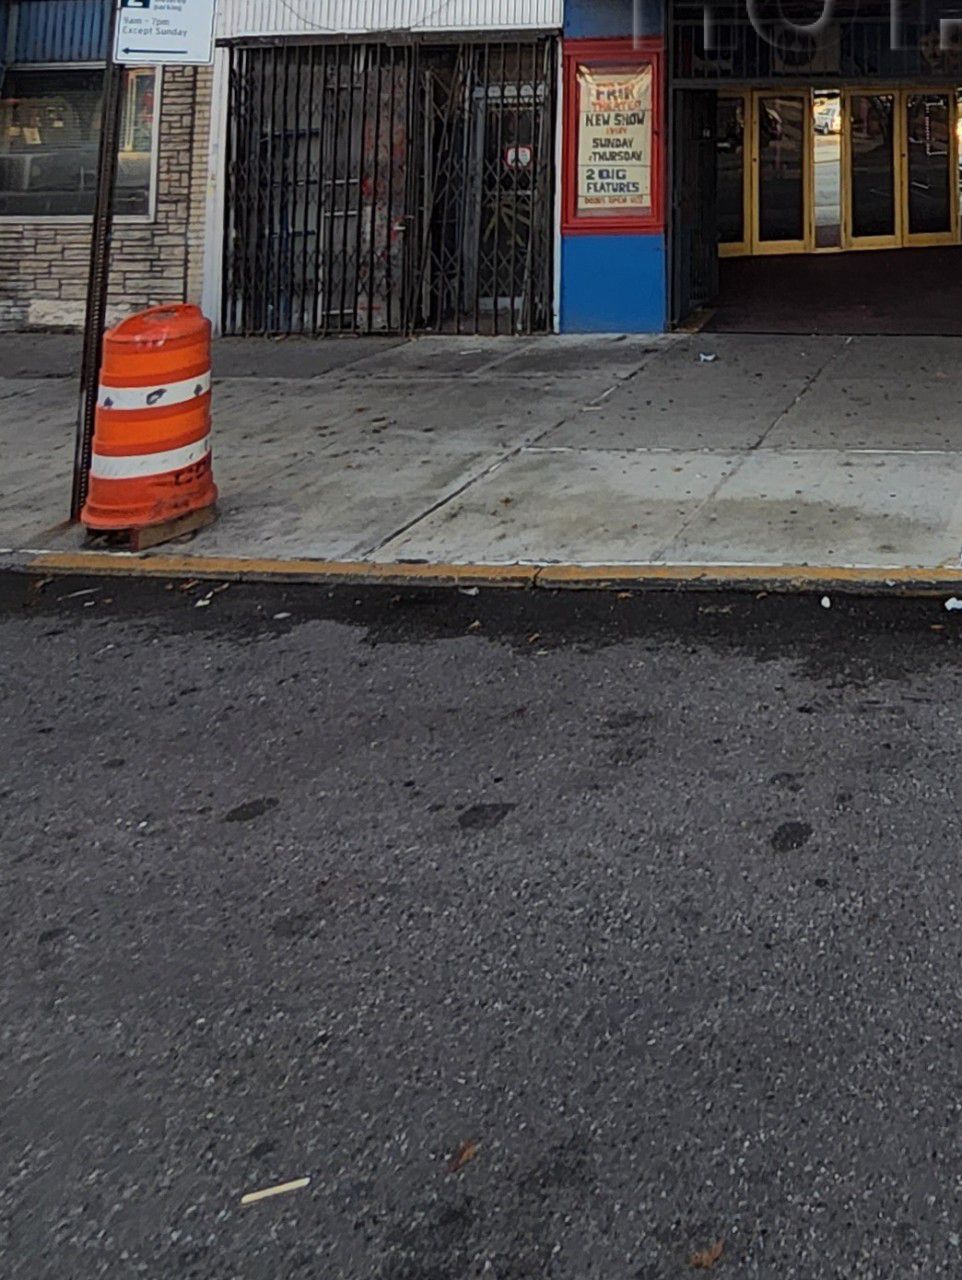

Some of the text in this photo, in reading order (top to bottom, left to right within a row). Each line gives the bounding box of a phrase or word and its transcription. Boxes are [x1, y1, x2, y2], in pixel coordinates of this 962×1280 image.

[154, 4, 182, 12] parking
[152, 17, 170, 26] 7pm
[122, 26, 188, 37] Except Sunday
[585, 111, 645, 126] NEW SHOW
[592, 137, 634, 148] SUNDAY
[586, 168, 595, 180] 2
[586, 181, 640, 193] FEATURES
